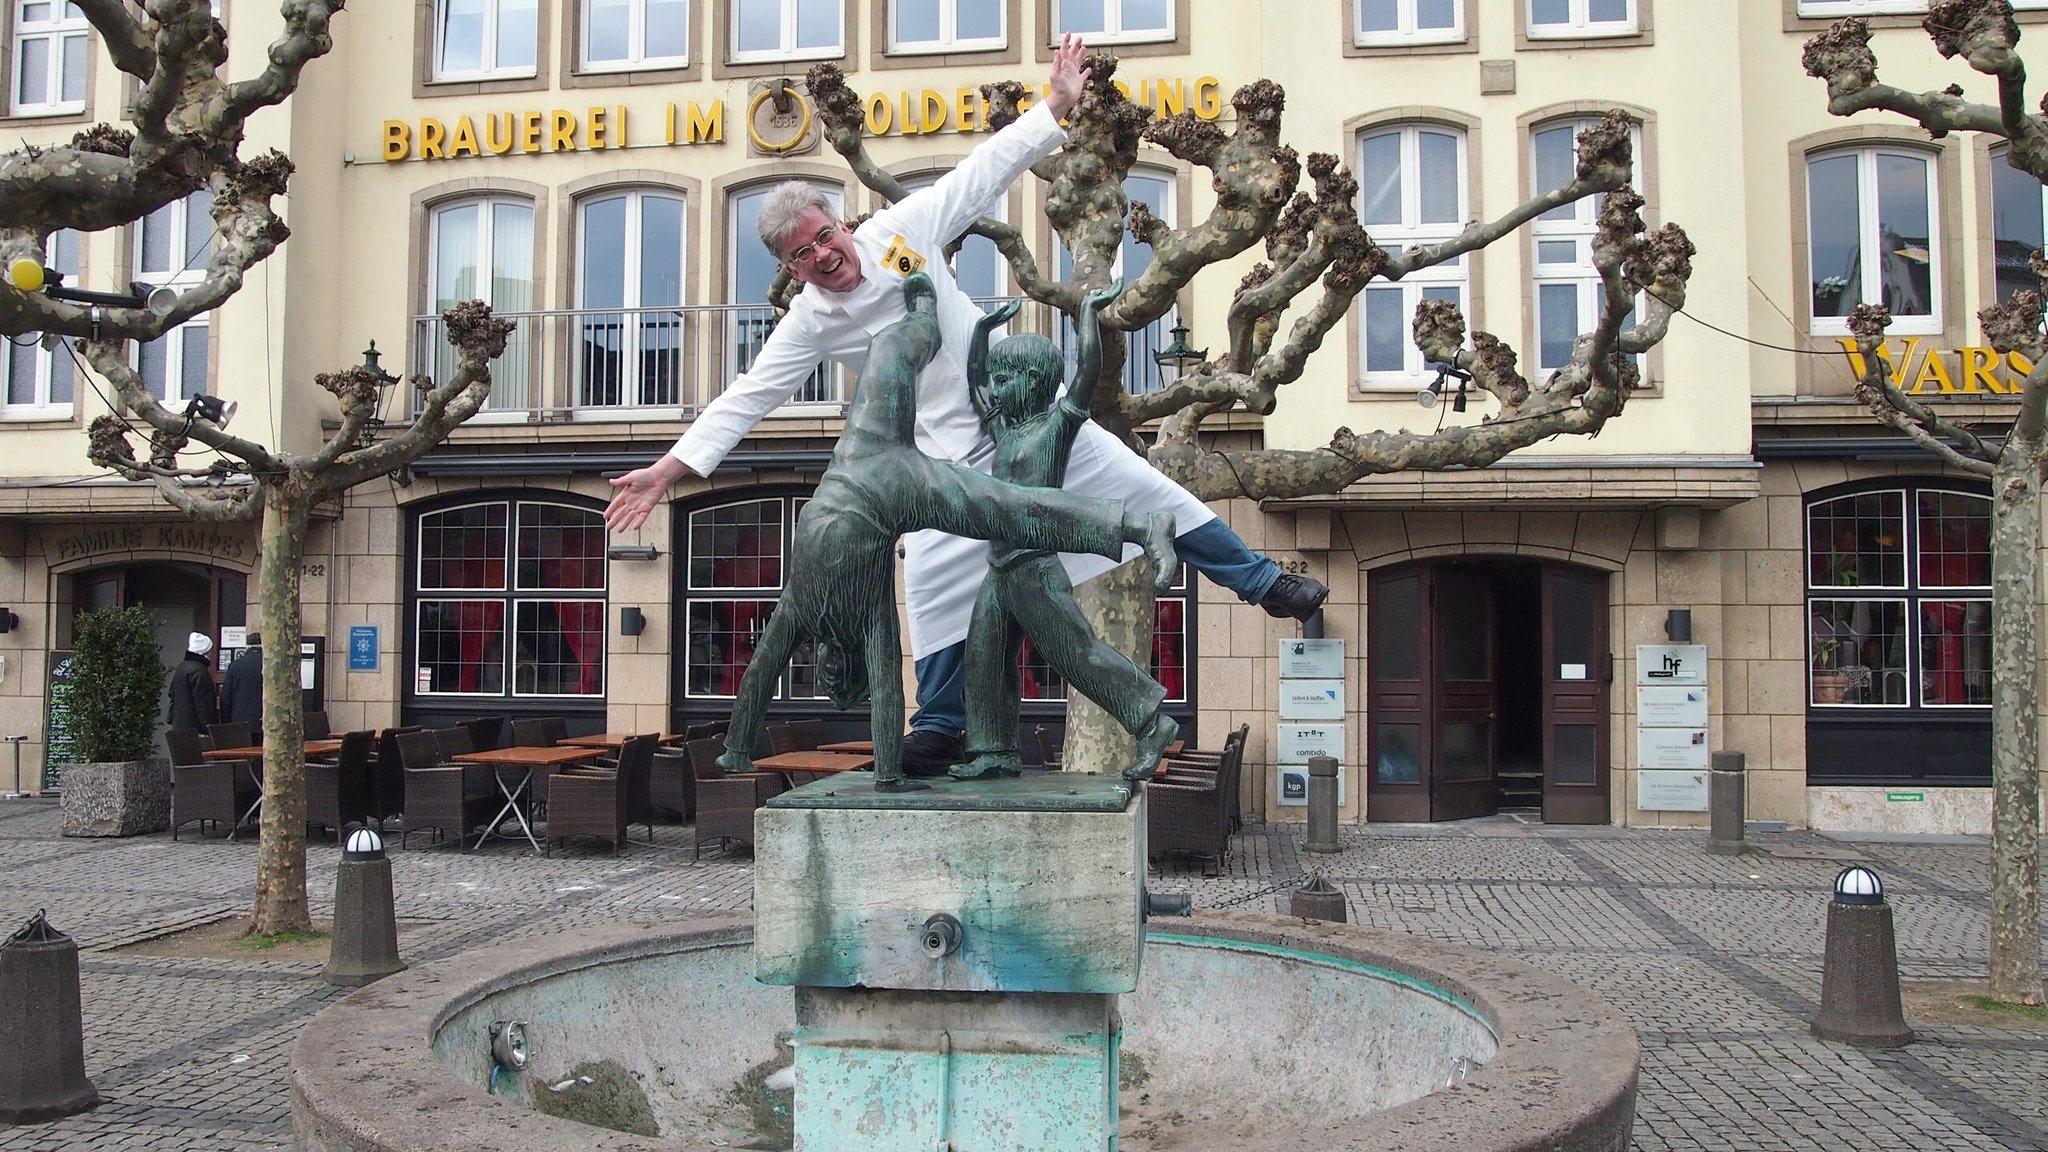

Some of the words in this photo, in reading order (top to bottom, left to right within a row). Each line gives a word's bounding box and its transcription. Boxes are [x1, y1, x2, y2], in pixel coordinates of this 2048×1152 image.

[383, 104, 628, 162] BRAUEREI
[665, 98, 725, 145] IM
[57, 527, 142, 560] FAMILIE
[158, 526, 245, 559] KAMPES
[1287, 781, 1302, 792] kgp
